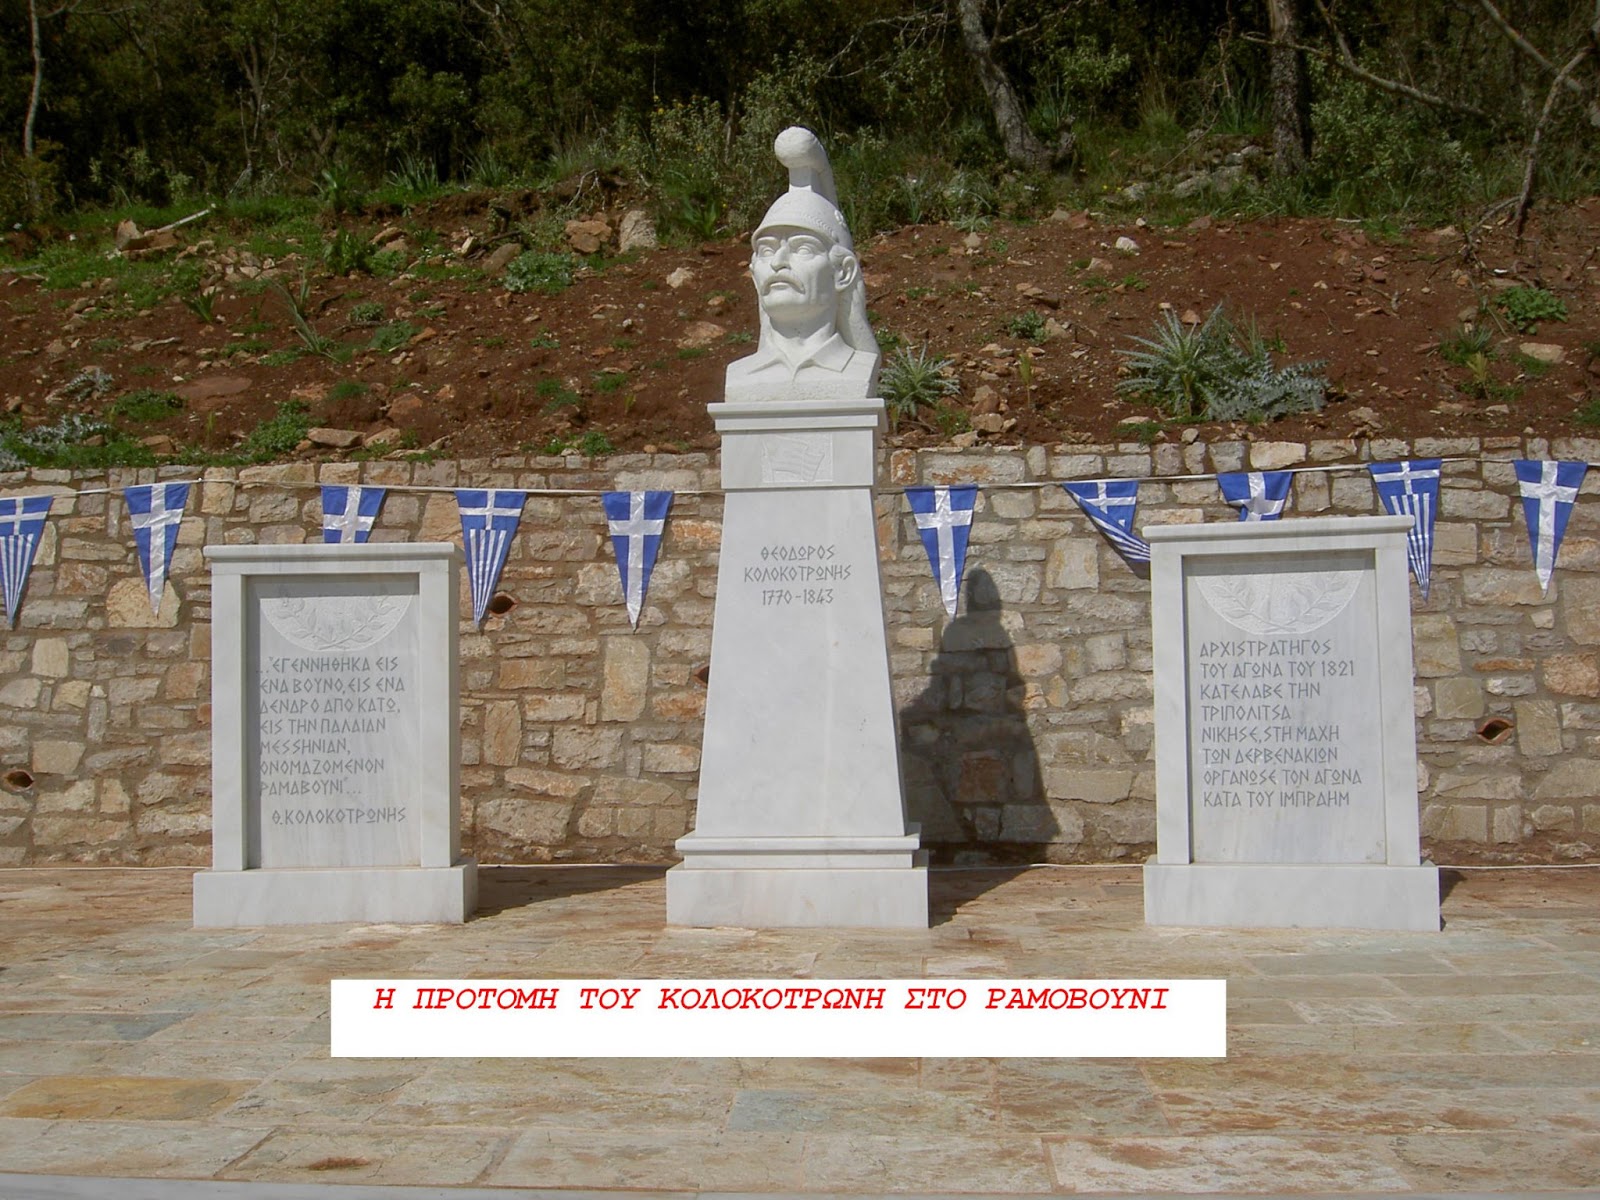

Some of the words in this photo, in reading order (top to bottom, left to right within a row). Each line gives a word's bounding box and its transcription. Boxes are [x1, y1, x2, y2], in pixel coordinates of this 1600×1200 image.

[760, 545, 835, 561] ΘΕΟΔΩΡΟΣ
[744, 564, 852, 583] ΚΟΛΟΚΟΤΡΩΝΗΣ
[1200, 639, 1332, 658] ΑΡΧΙΣΤΡΑΤΗΓΟΣ
[375, 656, 399, 672] ΕΙΣ
[1200, 662, 1227, 678] ΤΟΥ
[1232, 661, 1283, 678] ΑΓΩΝΑ
[1288, 661, 1316, 677] ΤΟΥ
[1321, 660, 1354, 677] 1821
[259, 678, 289, 694] ΕΝΑ
[348, 677, 371, 693] ΕΙΣ
[375, 677, 405, 693] ΕΝΑ
[1200, 683, 1283, 700] ΚΑΤΕΛΑΒΕ
[1288, 682, 1321, 699] ΤΗΝ
[259, 698, 320, 714] ΔΕΝΔΡΟ
[323, 698, 354, 713] ΑΠΟ
[1201, 705, 1291, 721] ΤΡΙΠΟΛΙΤΣΑ
[259, 719, 283, 735] ΕΙΣ
[288, 718, 318, 734] ΤΗΝ
[321, 717, 386, 734] ΠΑΛΑΙΑΝ
[1264, 726, 1292, 742] ΣΤΗ
[1296, 725, 1339, 742] ΜΑΧΗ
[1203, 748, 1230, 764] ΤΩΝ
[1235, 747, 1338, 764] ΔΕΡΒΕΝΑΚΙΩΝ
[259, 758, 385, 775] ΟΝΟΜΑΖΟΜΕΝΟΝ
[1203, 769, 1277, 786] ΟΡΓΑΝΩΣΕ
[1282, 769, 1309, 785] ΤΟΝ
[1314, 768, 1362, 785] ΑΓΩΝΑ
[1203, 791, 1242, 807] ΚΑΤΑ
[1247, 791, 1274, 807] ΤΟΥ
[1280, 790, 1350, 808] ΙΜΠΡΑΗΜ
[285, 807, 406, 825] ΚΟΛΟΚΟΤΡΩΝΗΣ
